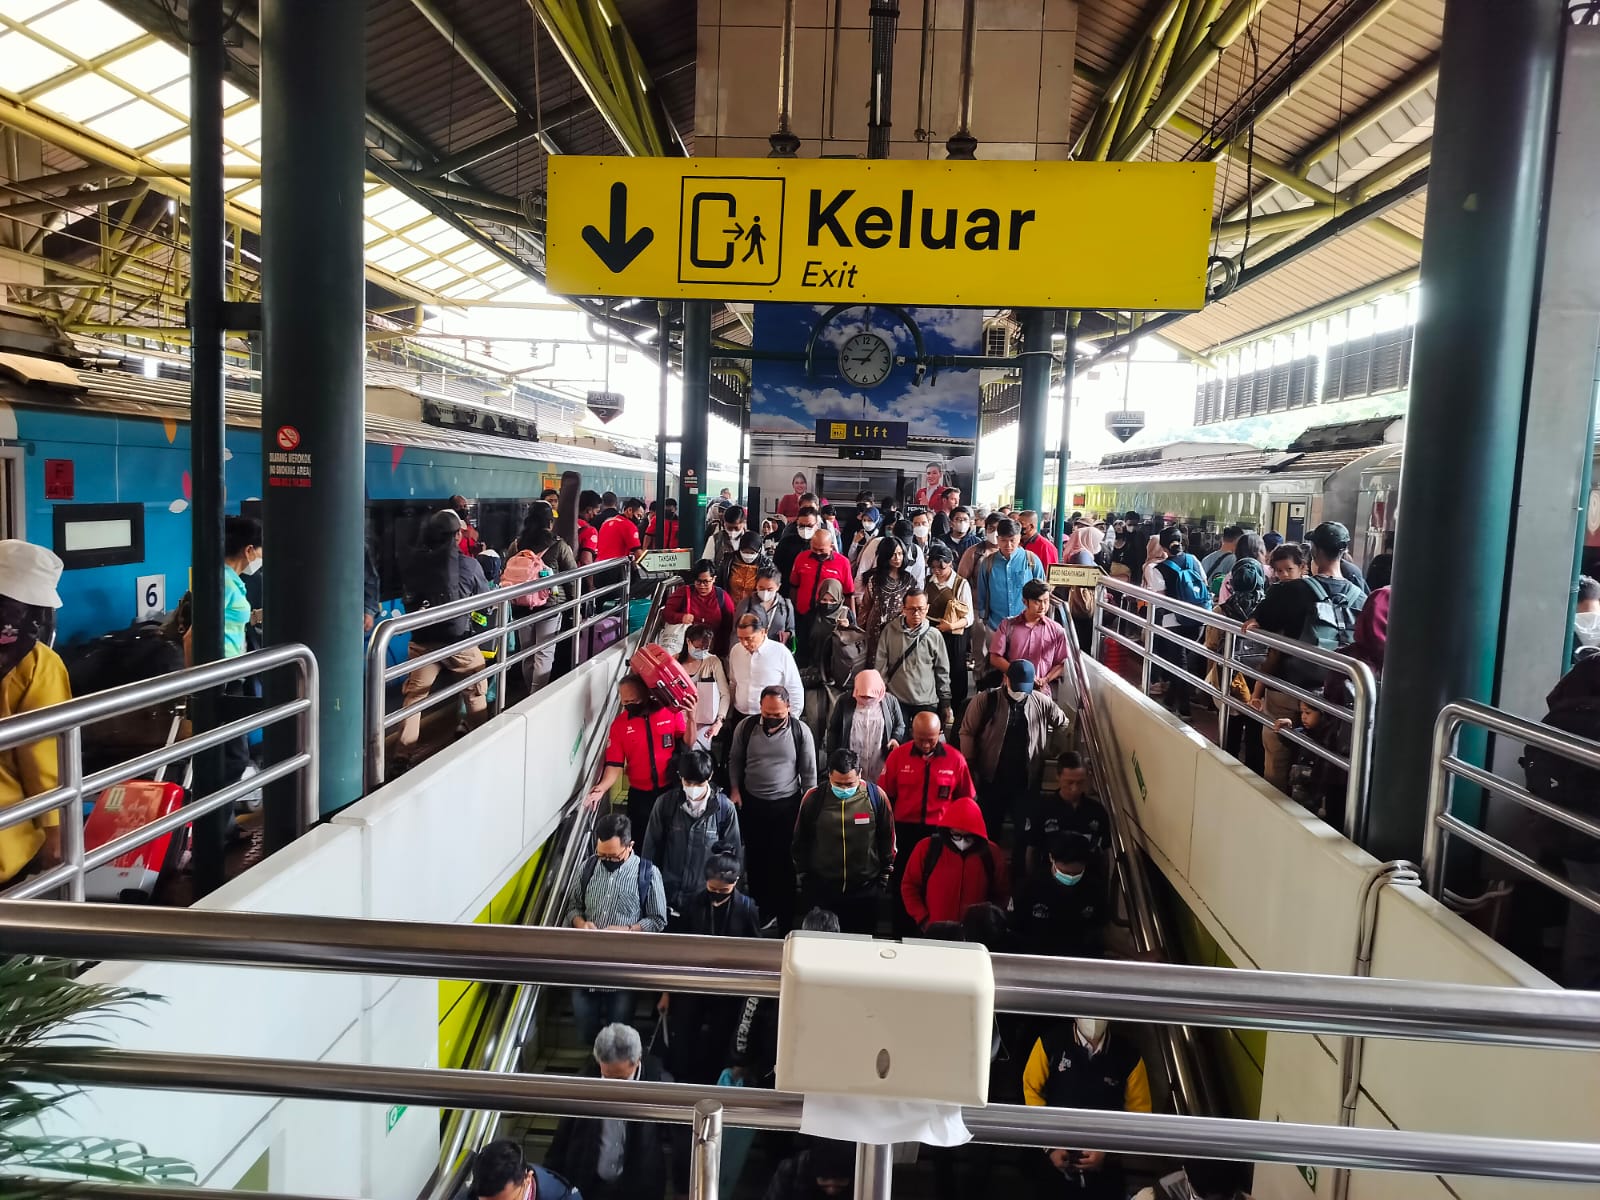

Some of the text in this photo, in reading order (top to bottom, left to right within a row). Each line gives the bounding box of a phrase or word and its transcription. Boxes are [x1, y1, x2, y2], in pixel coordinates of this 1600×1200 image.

[807, 189, 1036, 250] Keluar
[801, 261, 858, 288] Exit
[863, 336, 870, 344] 12
[598, 409, 607, 418] 2
[854, 425, 888, 438] Lift
[1120, 428, 1131, 437] 1
[145, 583, 158, 608] 6
